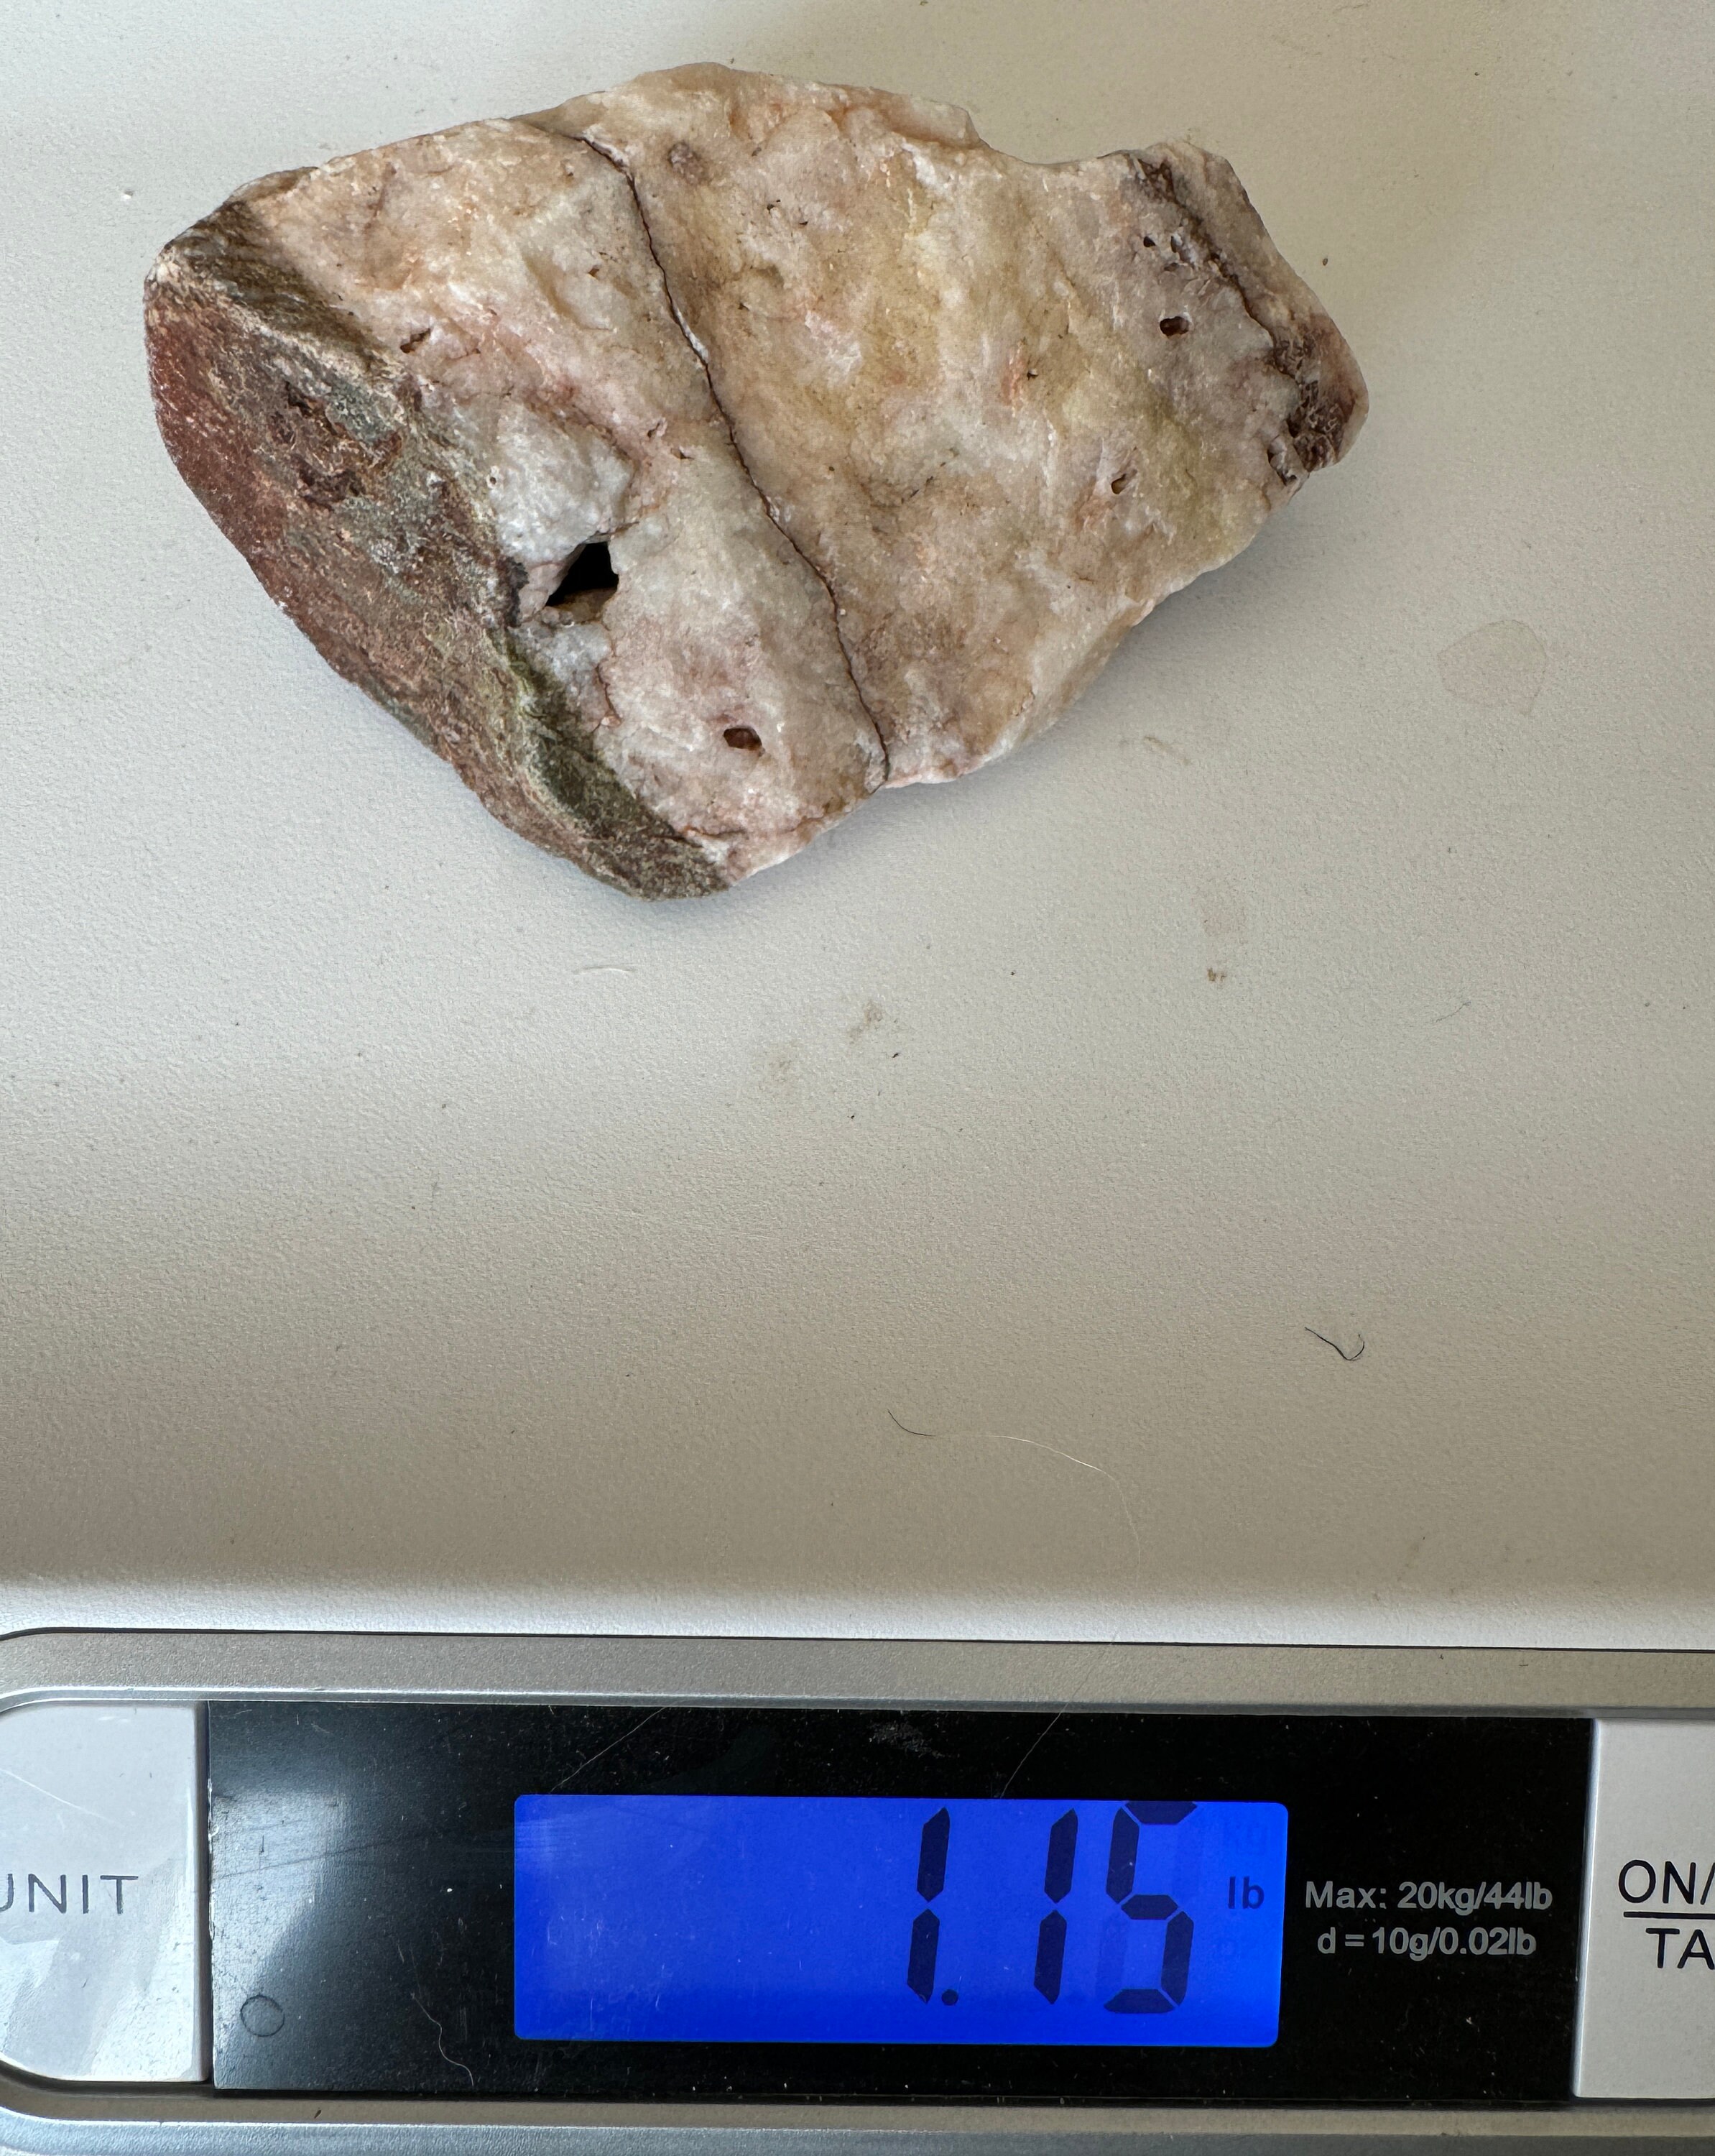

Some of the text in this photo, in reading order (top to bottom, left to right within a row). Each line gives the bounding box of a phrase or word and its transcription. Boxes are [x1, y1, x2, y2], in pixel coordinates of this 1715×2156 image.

[1305, 1881, 1553, 1916] Max: 20kg/44lb
[1618, 1859, 1715, 1904] ON/
[907, 1800, 1265, 2013] 1.15 lb
